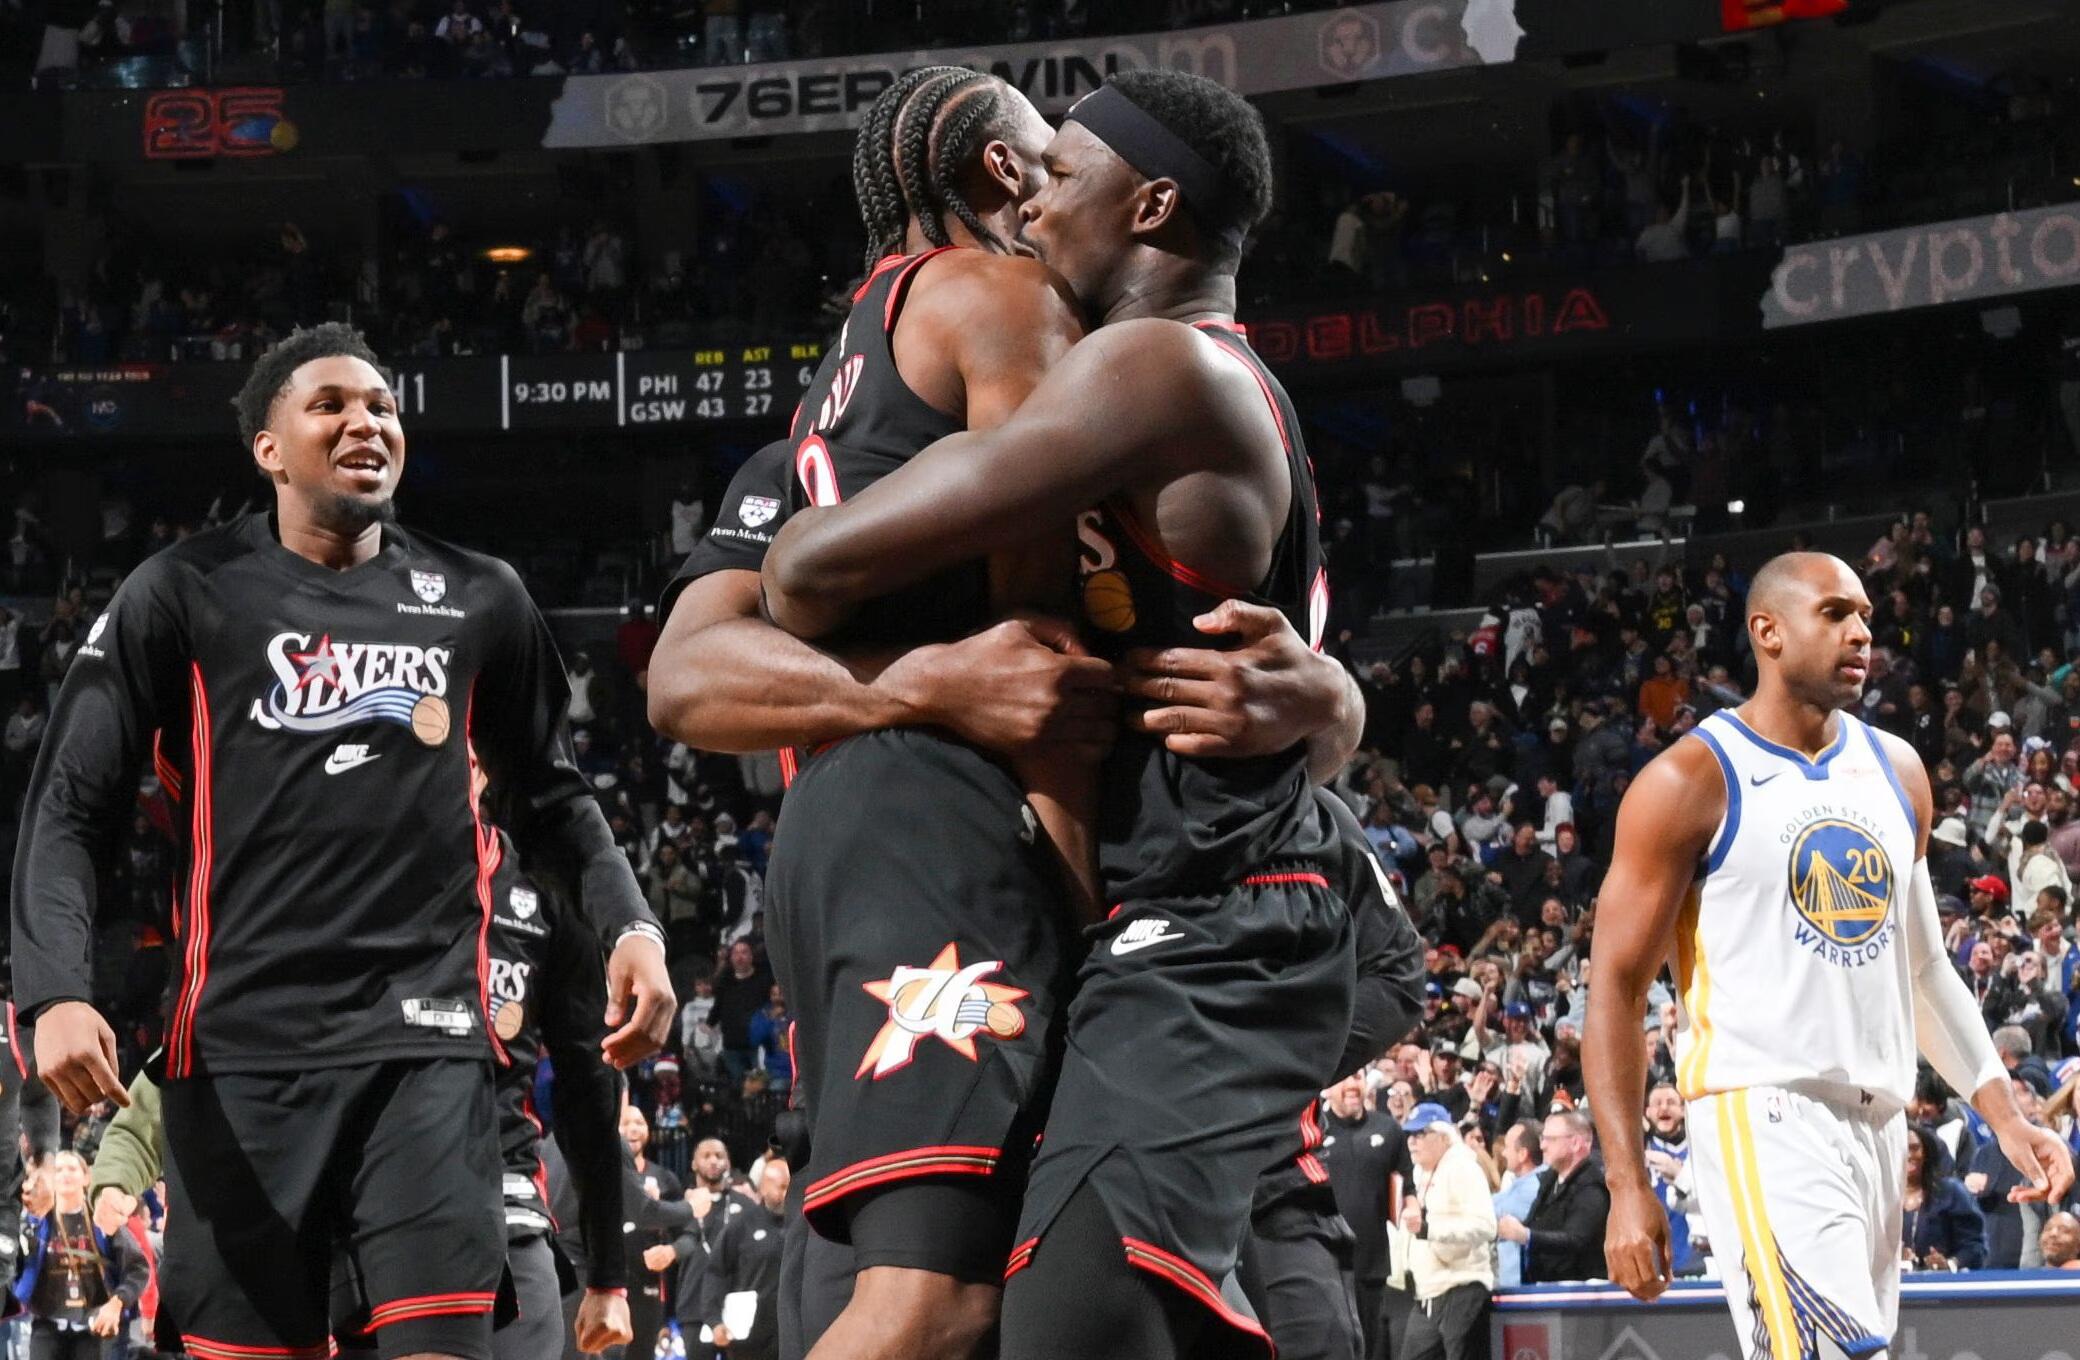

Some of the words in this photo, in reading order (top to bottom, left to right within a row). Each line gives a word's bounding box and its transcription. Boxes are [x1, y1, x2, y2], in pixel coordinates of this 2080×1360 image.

[1771, 212, 2080, 315] crypto
[695, 351, 724, 365] REB
[743, 348, 770, 362] AST
[791, 345, 819, 359] BLK
[515, 382, 566, 403] 9:30
[573, 381, 611, 401] PM
[639, 374, 678, 396] PHI
[696, 372, 724, 391] 47
[744, 369, 771, 388] 23
[630, 401, 685, 422] GSW
[696, 398, 725, 418] 43
[745, 395, 772, 415] 27
[250, 632, 451, 729] SIXERS
[333, 744, 370, 761] NIKE
[1780, 804, 1833, 844] GOLDEN
[1841, 806, 1886, 839] STATE
[1846, 848, 1884, 884] 20
[1122, 919, 1170, 942] NIKE
[1793, 919, 1896, 968] WARRIORS
